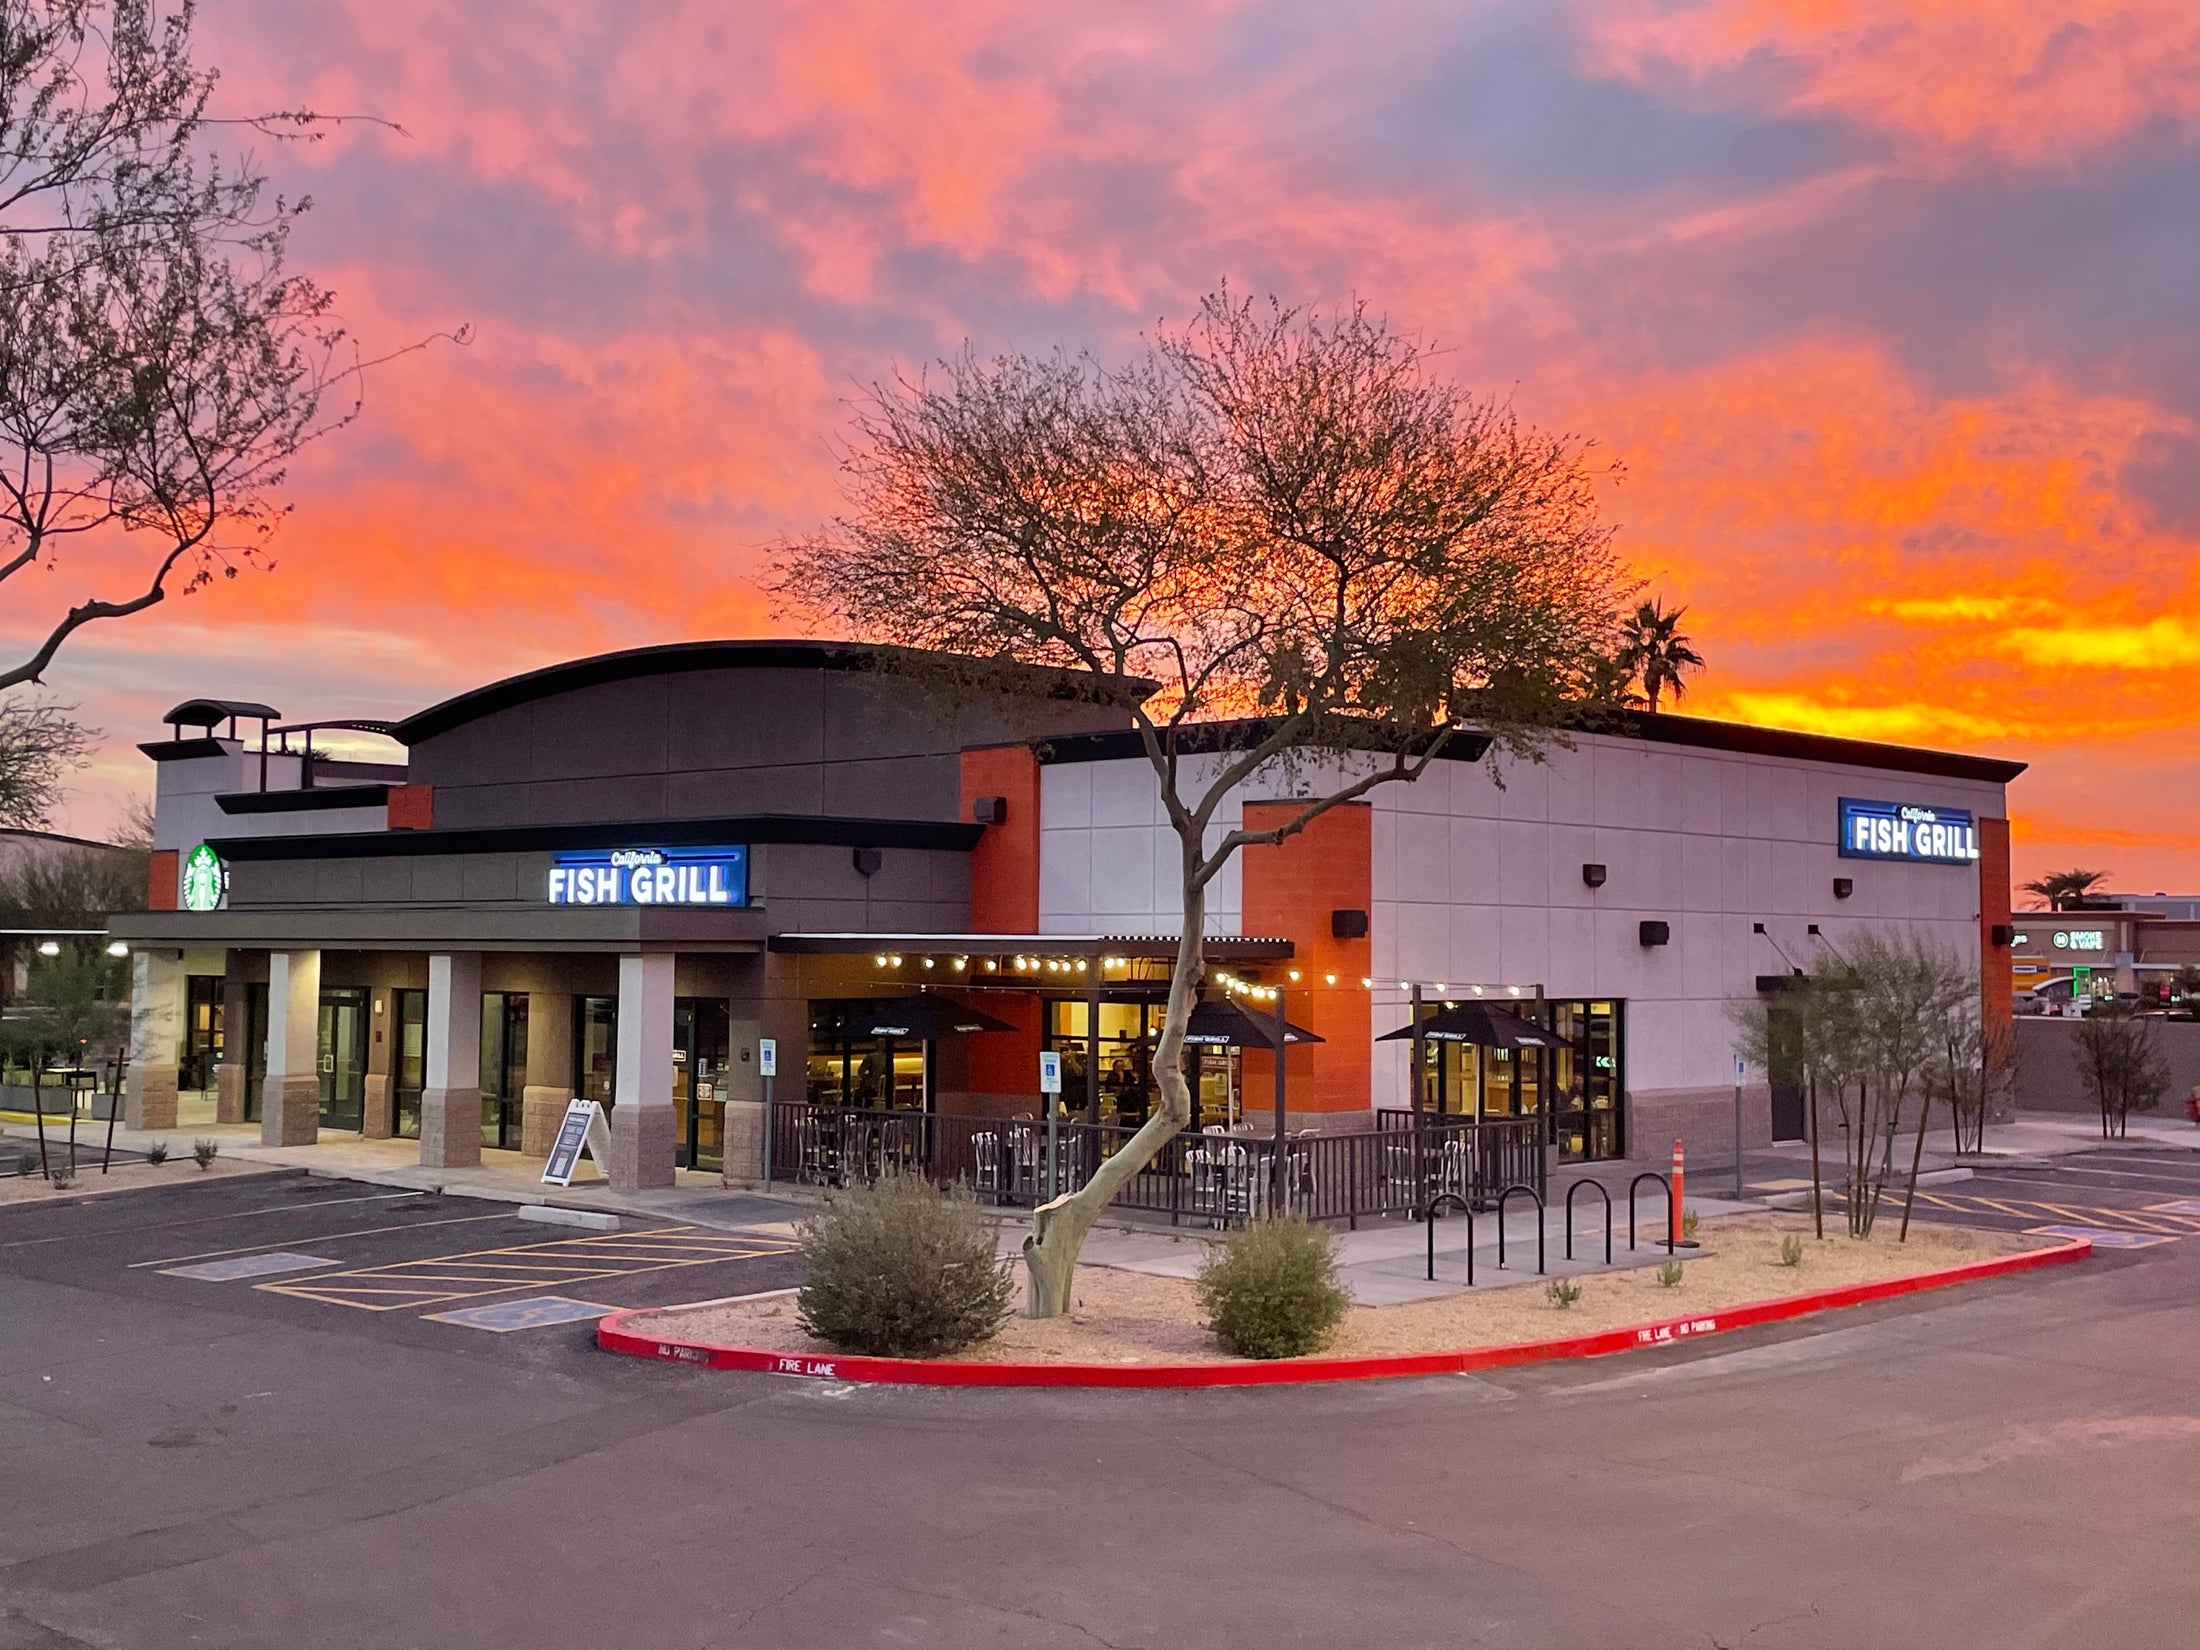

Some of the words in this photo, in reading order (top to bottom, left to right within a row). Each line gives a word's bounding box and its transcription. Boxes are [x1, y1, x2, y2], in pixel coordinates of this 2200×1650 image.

[1901, 807, 1936, 823] California
[1856, 817, 1908, 852] FISH
[1915, 823, 1979, 858] GRILL
[611, 851, 661, 869] California
[549, 867, 619, 904] FISH
[630, 865, 727, 903] GRILL
[2070, 931, 2103, 941] SMOKE
[2080, 939, 2103, 950] VAPE
[659, 1343, 670, 1356] NO
[779, 1359, 801, 1371] FIRE
[807, 1362, 835, 1375] LANE
